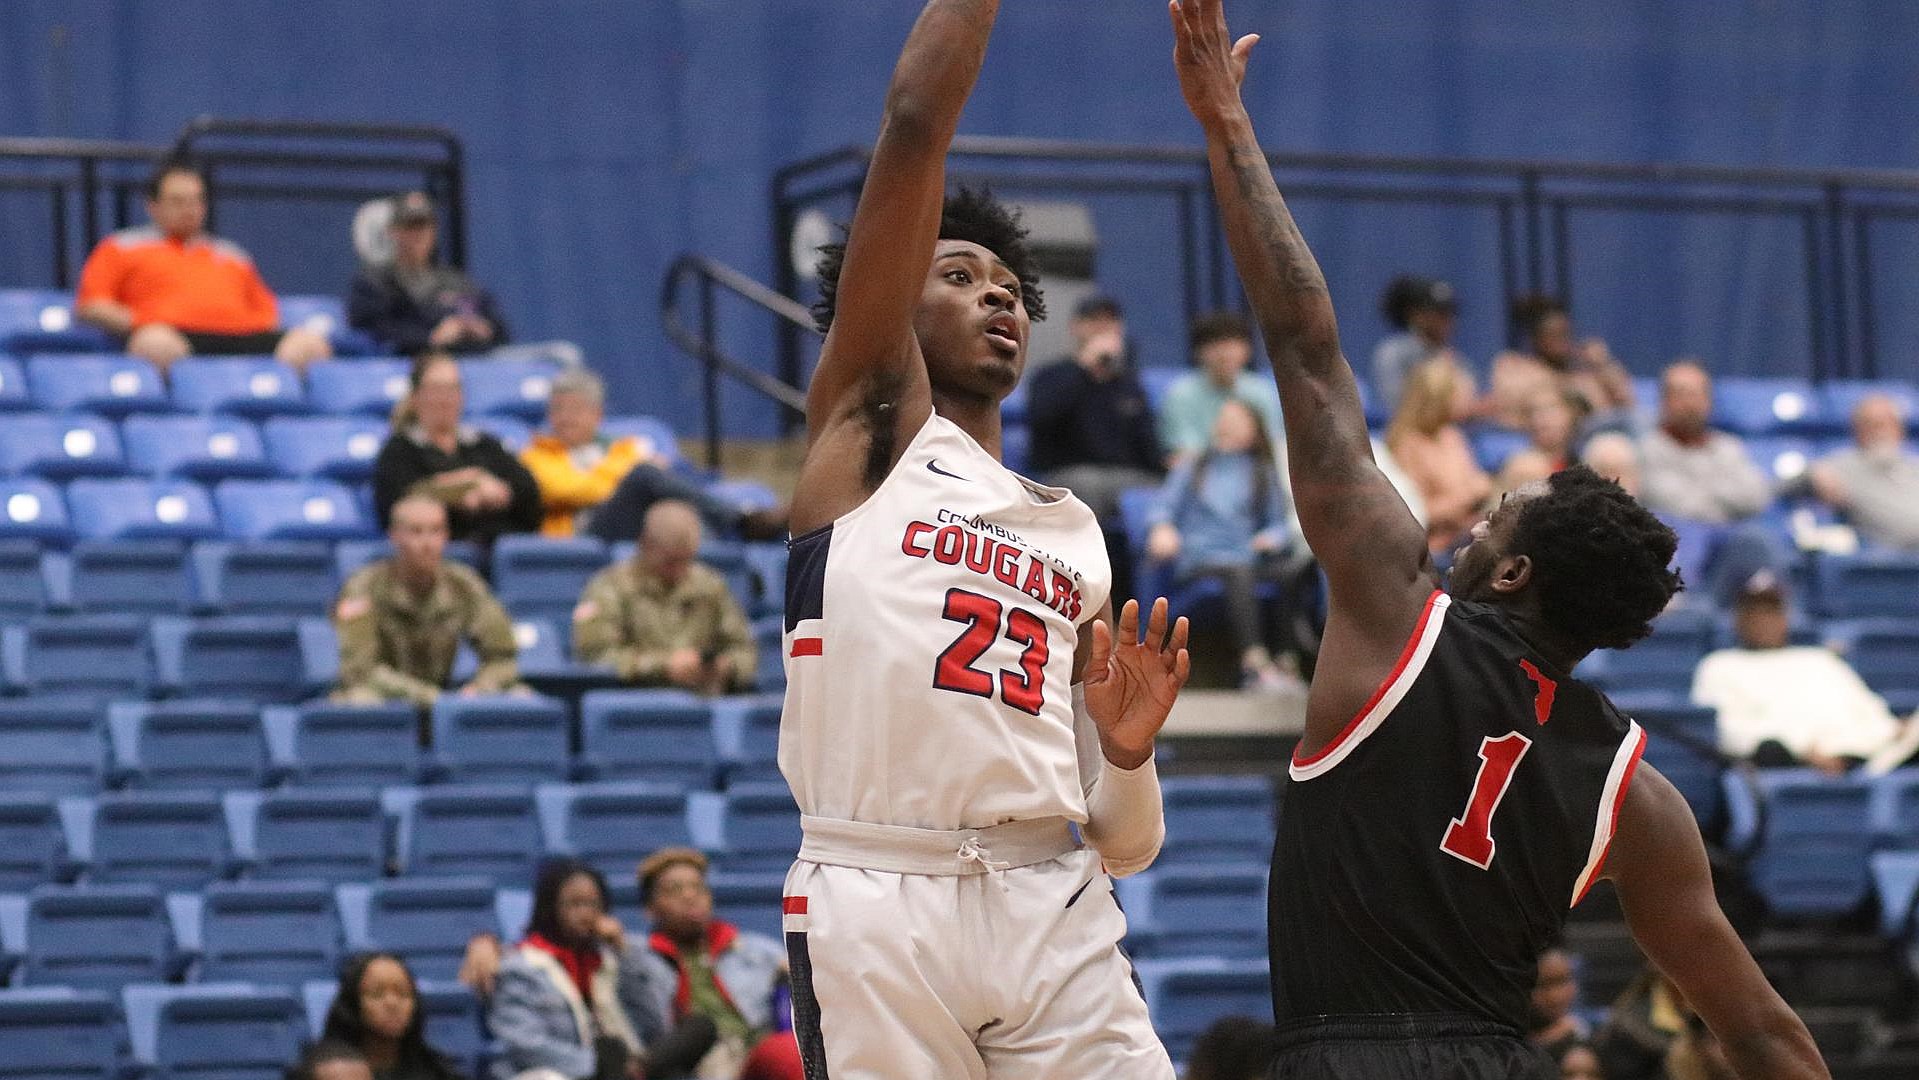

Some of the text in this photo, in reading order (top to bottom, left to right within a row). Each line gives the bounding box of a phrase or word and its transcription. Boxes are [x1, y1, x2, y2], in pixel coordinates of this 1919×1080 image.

[902, 521, 1082, 621] COUGARS
[933, 587, 1049, 716] 23
[1439, 731, 1533, 871] 1
